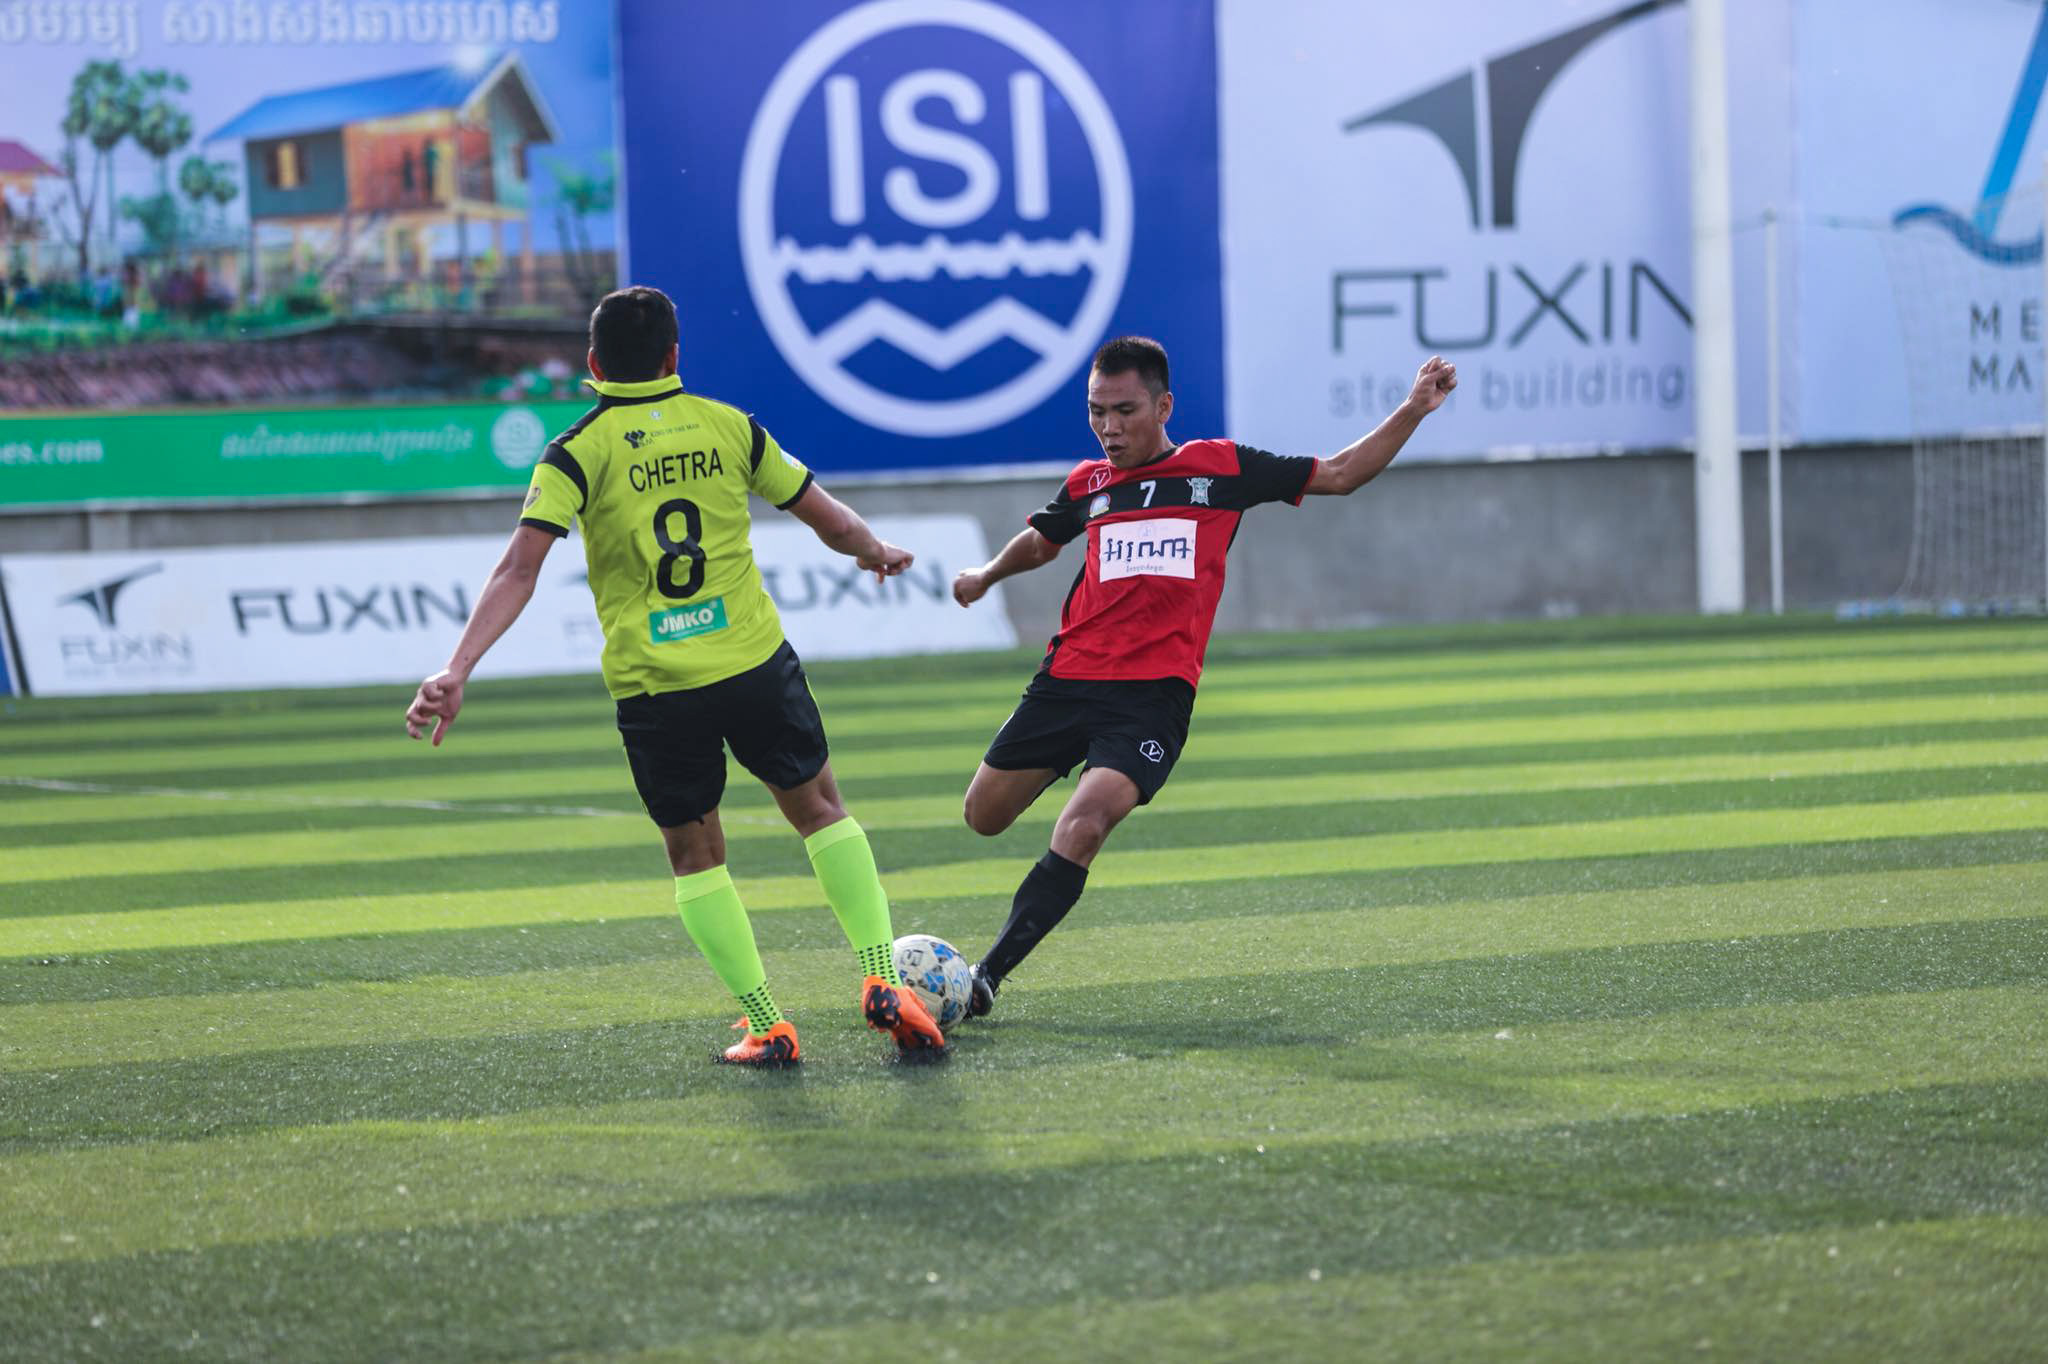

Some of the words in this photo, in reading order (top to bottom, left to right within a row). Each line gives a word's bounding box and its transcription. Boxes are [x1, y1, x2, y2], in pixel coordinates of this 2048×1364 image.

[824, 67, 1051, 230] ISI
[1331, 258, 1695, 354] FUXIN
[1480, 356, 1686, 411] building
[628, 447, 724, 492] CHETRA
[1140, 480, 1157, 508] 7
[653, 498, 707, 599] 8
[230, 581, 470, 637] FUXIN
[763, 557, 948, 612] UXIN
[657, 608, 714, 634] JMKO
